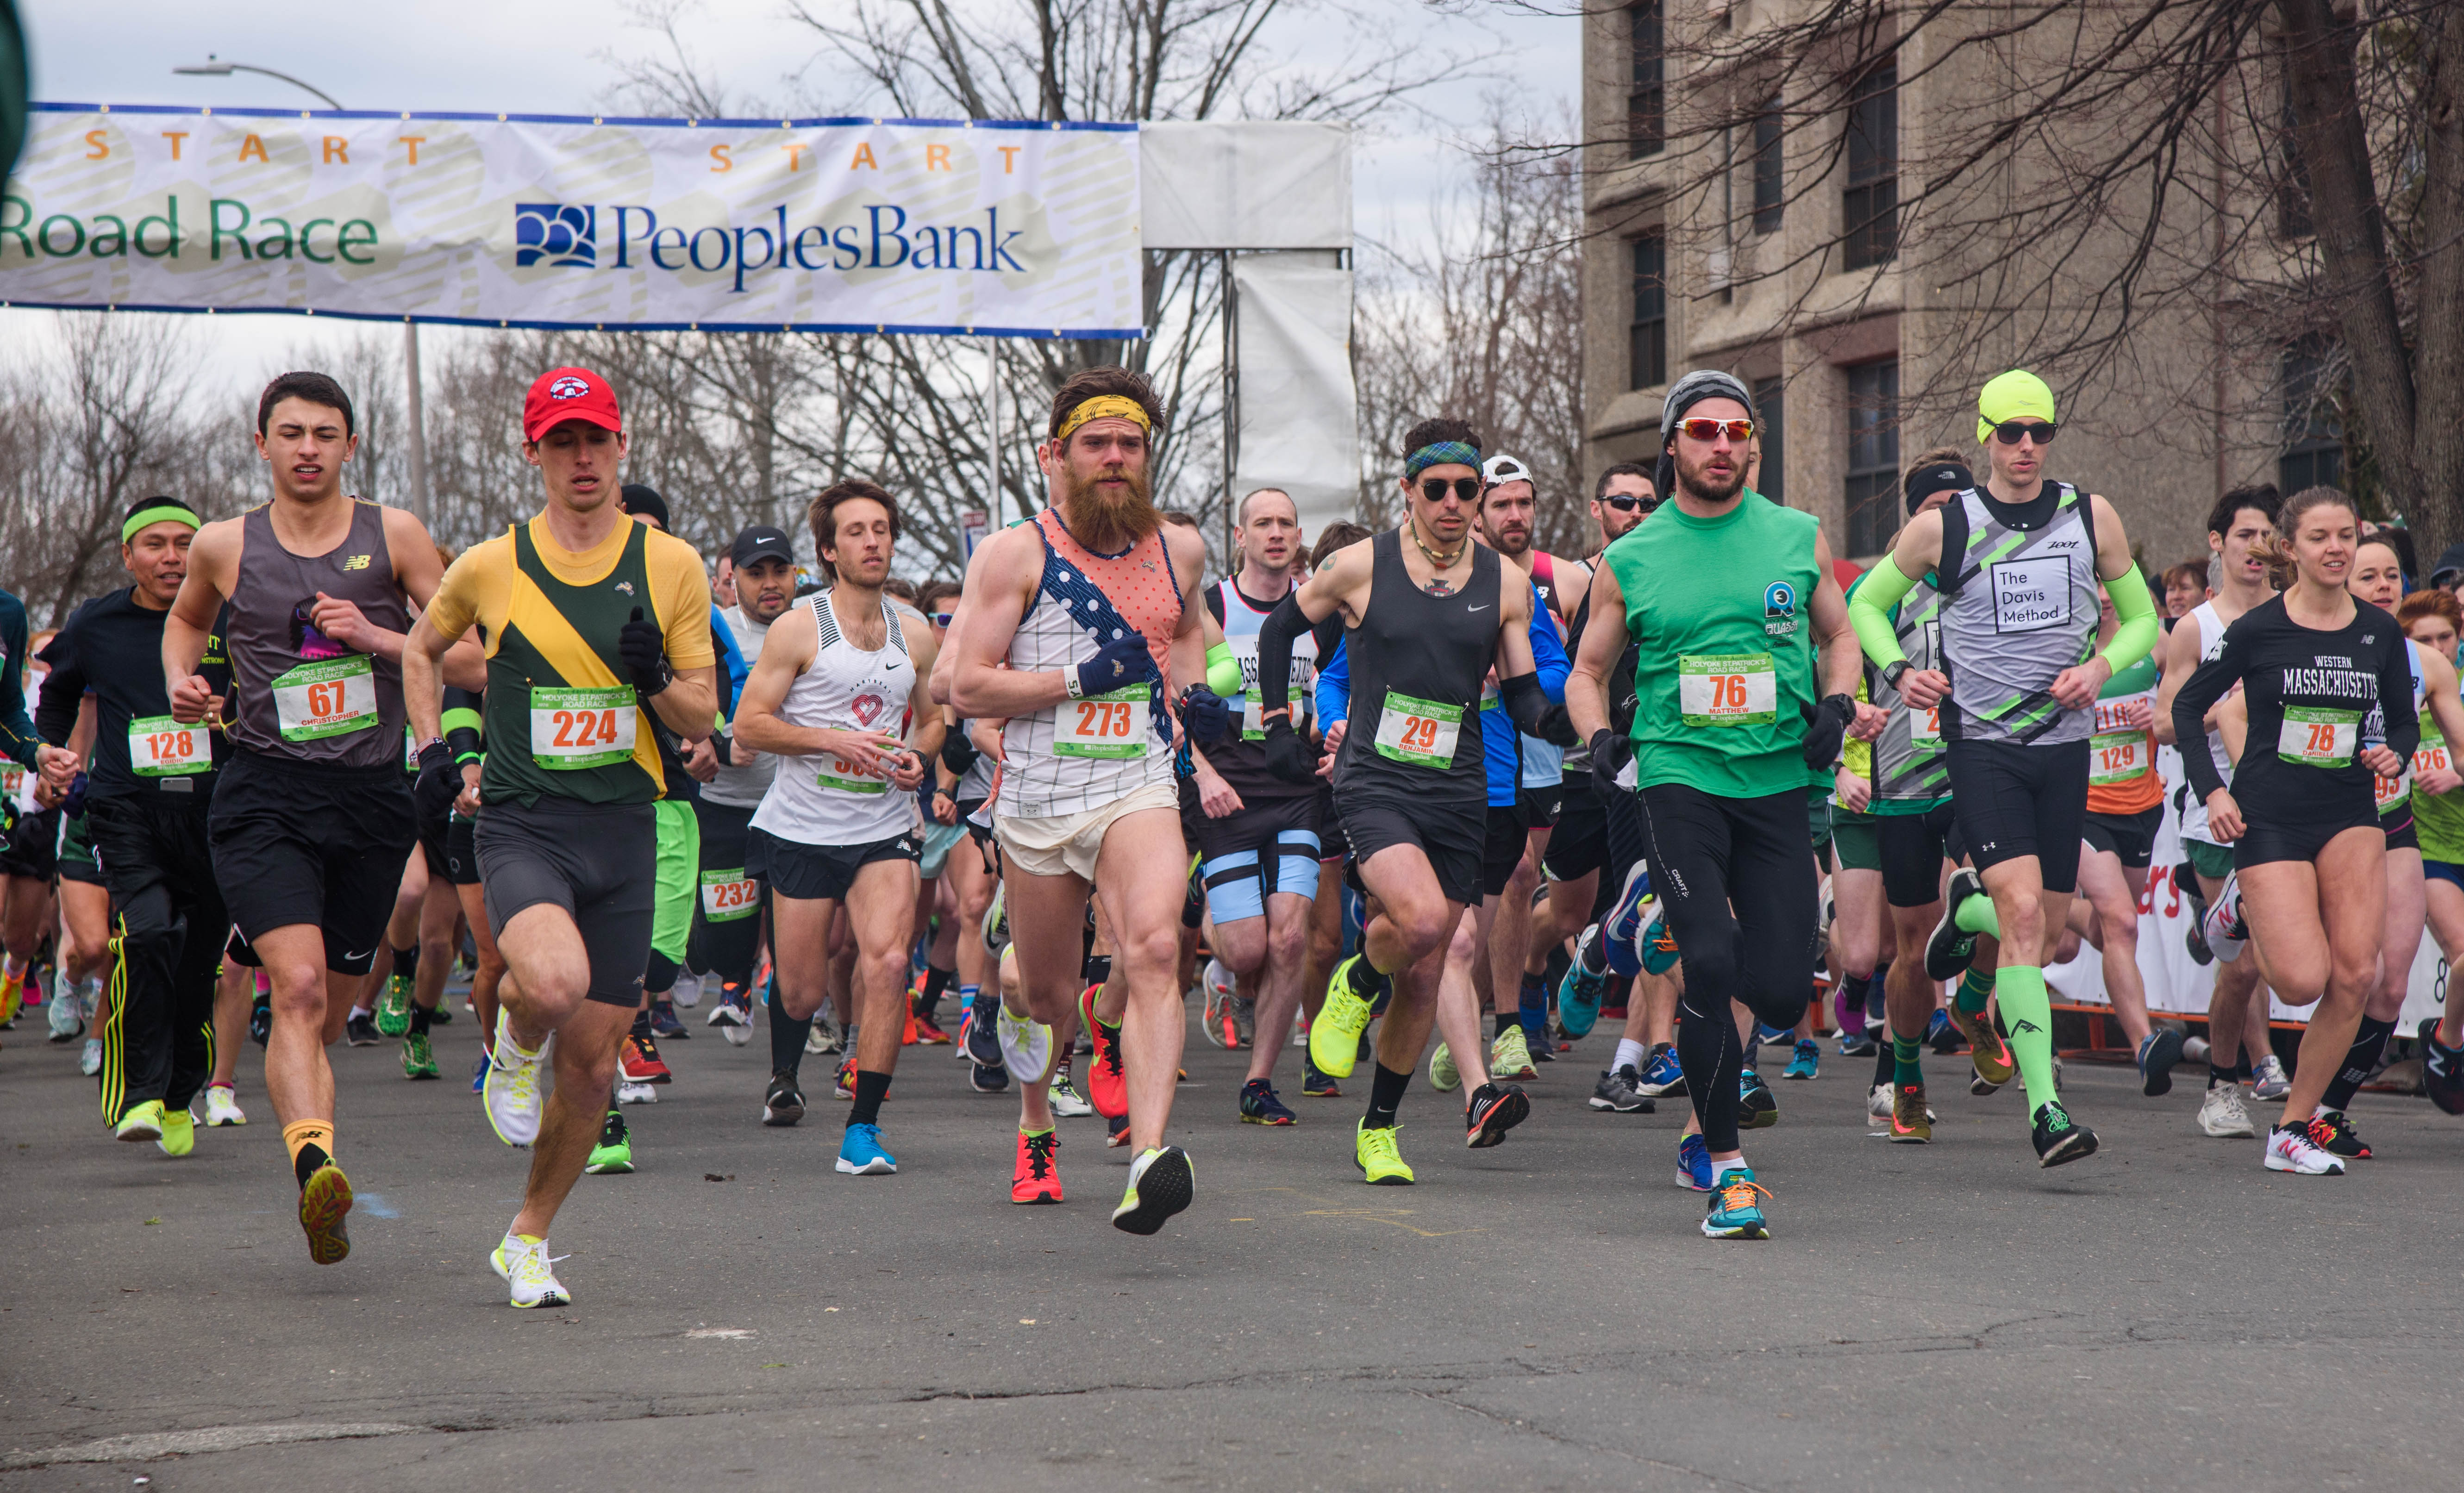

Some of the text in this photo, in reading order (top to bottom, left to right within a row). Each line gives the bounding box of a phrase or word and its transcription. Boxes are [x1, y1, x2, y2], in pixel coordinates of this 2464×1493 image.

[86, 130, 426, 165] START
[709, 142, 1021, 174] START
[0, 194, 378, 263] Road Race
[610, 204, 1026, 293] PeoplesBank
[2000, 572, 2027, 585] The
[2002, 591, 2045, 605] Davis
[2004, 605, 2058, 623] Method
[282, 669, 315, 680] HOLYOKE
[2315, 656, 2352, 668] WESTERN
[325, 671, 344, 680] RACE
[850, 679, 891, 693] HARTBEAT
[2283, 668, 2378, 700] MASSACHUSETTS
[308, 680, 344, 717] 67
[1709, 675, 1746, 707] 76
[1395, 699, 1421, 710] HOLYOKE
[301, 711, 359, 726] CHRISTOPHER
[553, 710, 617, 747] 224
[1076, 701, 1131, 737] 273
[1401, 716, 1438, 748] 29
[2307, 724, 2335, 751] 78
[146, 731, 193, 760] 128
[1399, 743, 1433, 755] BENJAMIN
[2099, 744, 2134, 770] 129
[2413, 749, 2446, 773] 126
[2, 772, 24, 789] 27
[1672, 869, 1687, 891] CRAFT
[714, 880, 756, 907] 232
